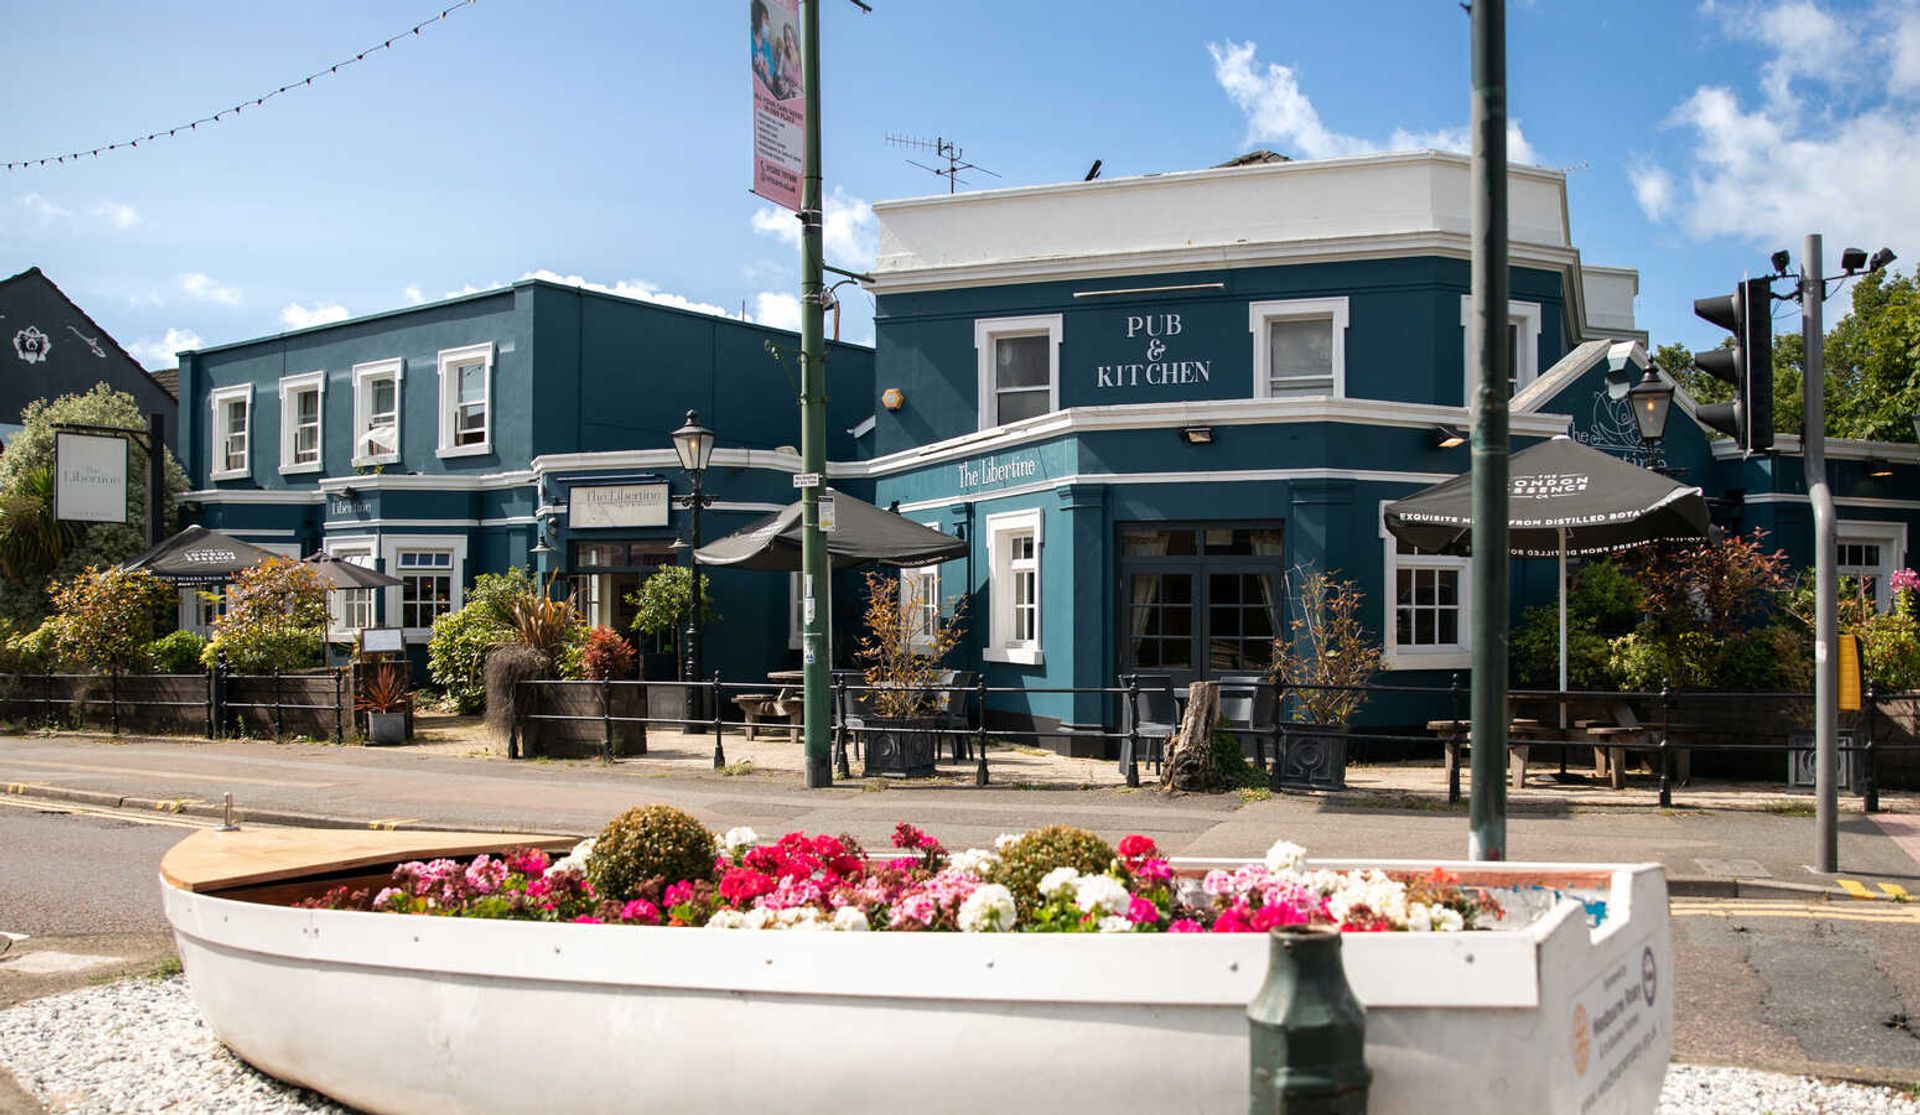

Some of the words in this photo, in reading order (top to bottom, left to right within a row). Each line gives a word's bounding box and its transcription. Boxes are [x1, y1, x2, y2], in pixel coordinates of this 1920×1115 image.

[1126, 313, 1182, 338] PUB
[1146, 337, 1167, 362] &
[1097, 360, 1211, 387] KITCHEN
[959, 460, 979, 489] The
[981, 455, 1036, 485] Libertine
[1506, 476, 1589, 487] ONDON
[609, 487, 662, 502] Libertine
[1506, 484, 1588, 495] SSENCE
[1399, 512, 1459, 524] EXQUISITE
[1508, 519, 1541, 527] FROM
[1545, 513, 1606, 526] DISTILLED
